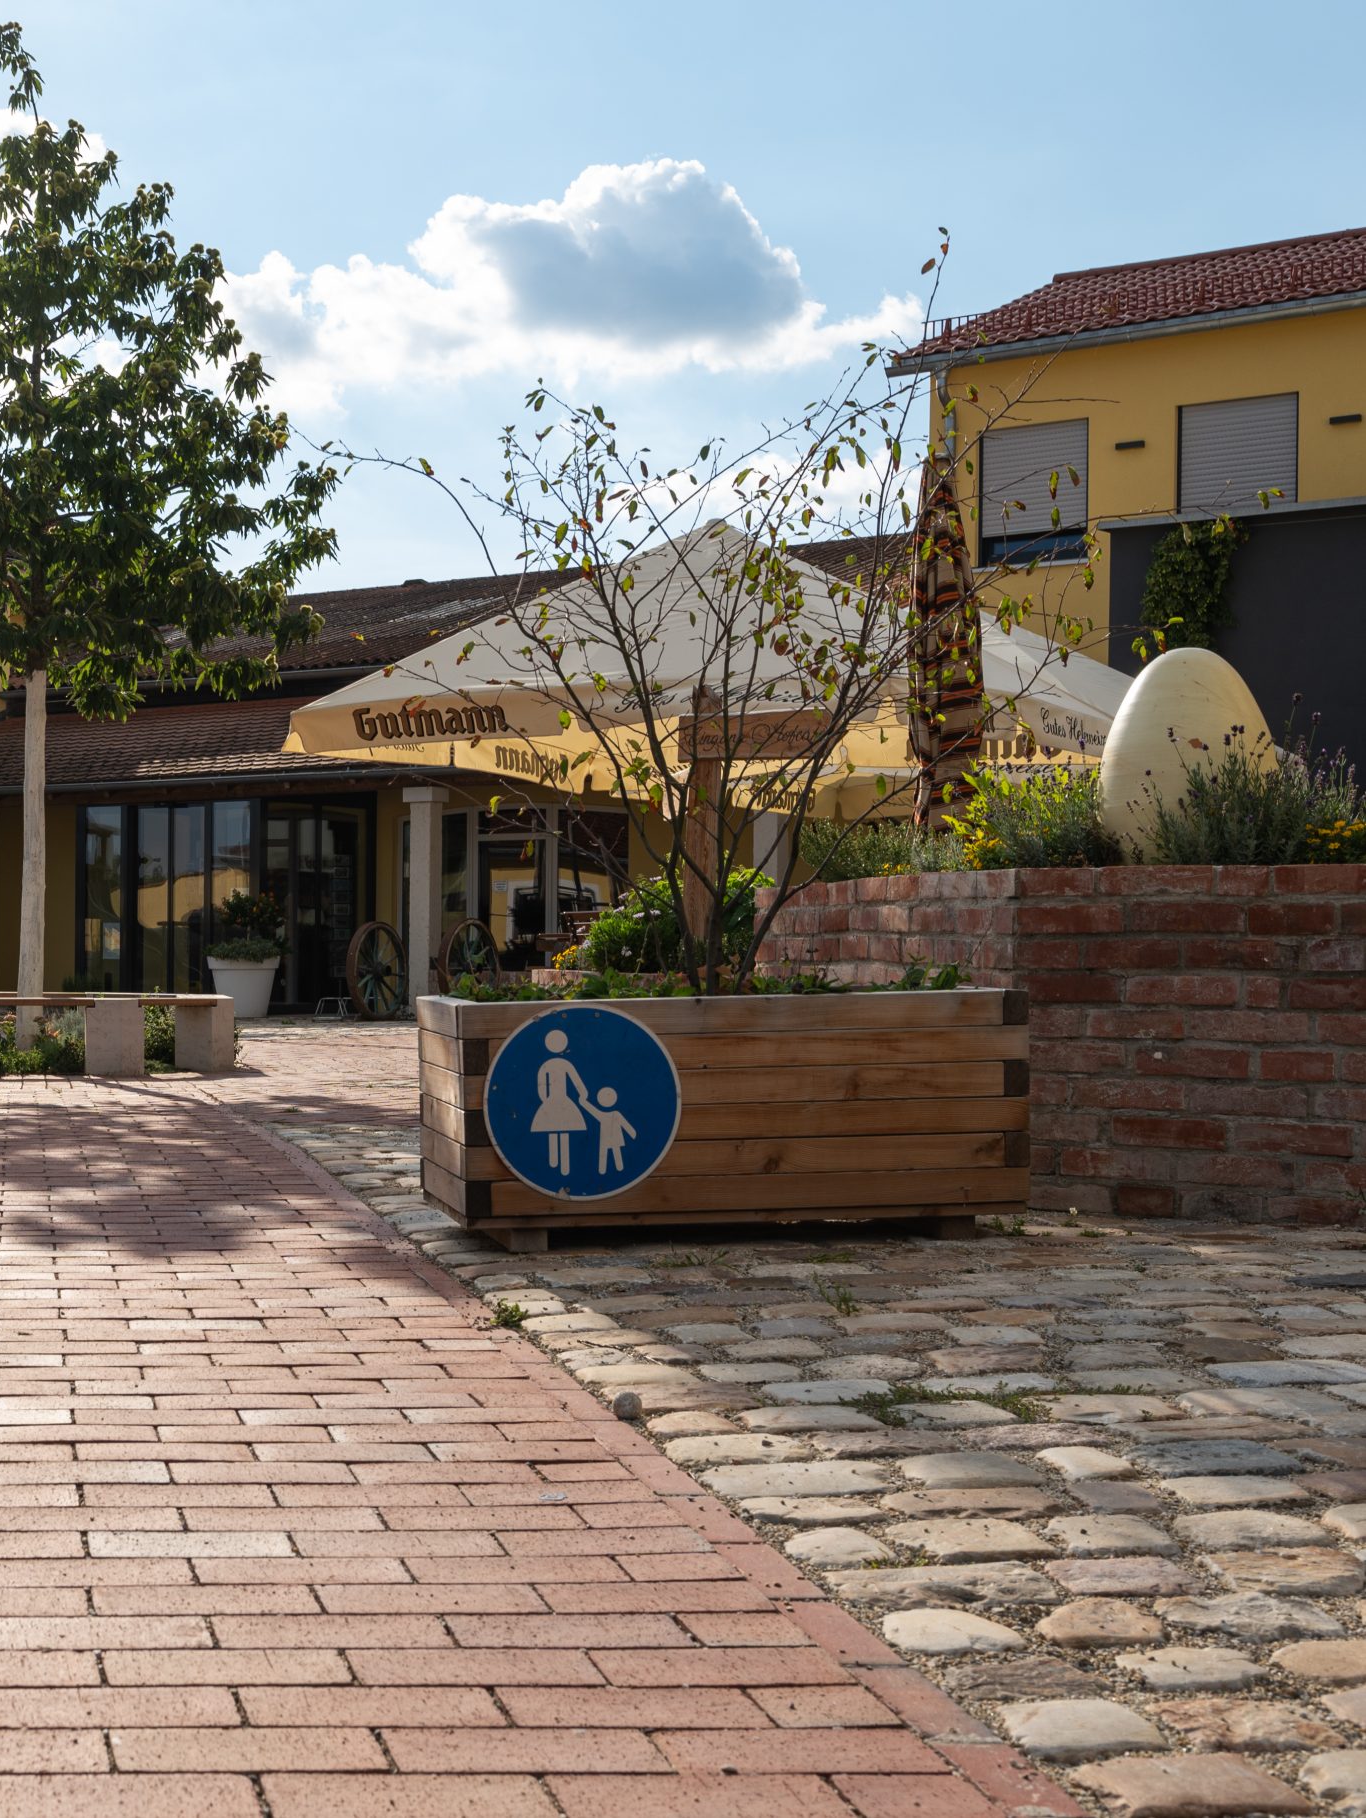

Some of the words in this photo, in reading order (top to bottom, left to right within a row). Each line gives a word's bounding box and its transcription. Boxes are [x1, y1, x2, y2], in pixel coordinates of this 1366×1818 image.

[615, 692, 677, 713] Gues
[352, 705, 509, 741] Gutmann
[1040, 707, 1066, 738] Gutes
[684, 727, 745, 751] Eingan
